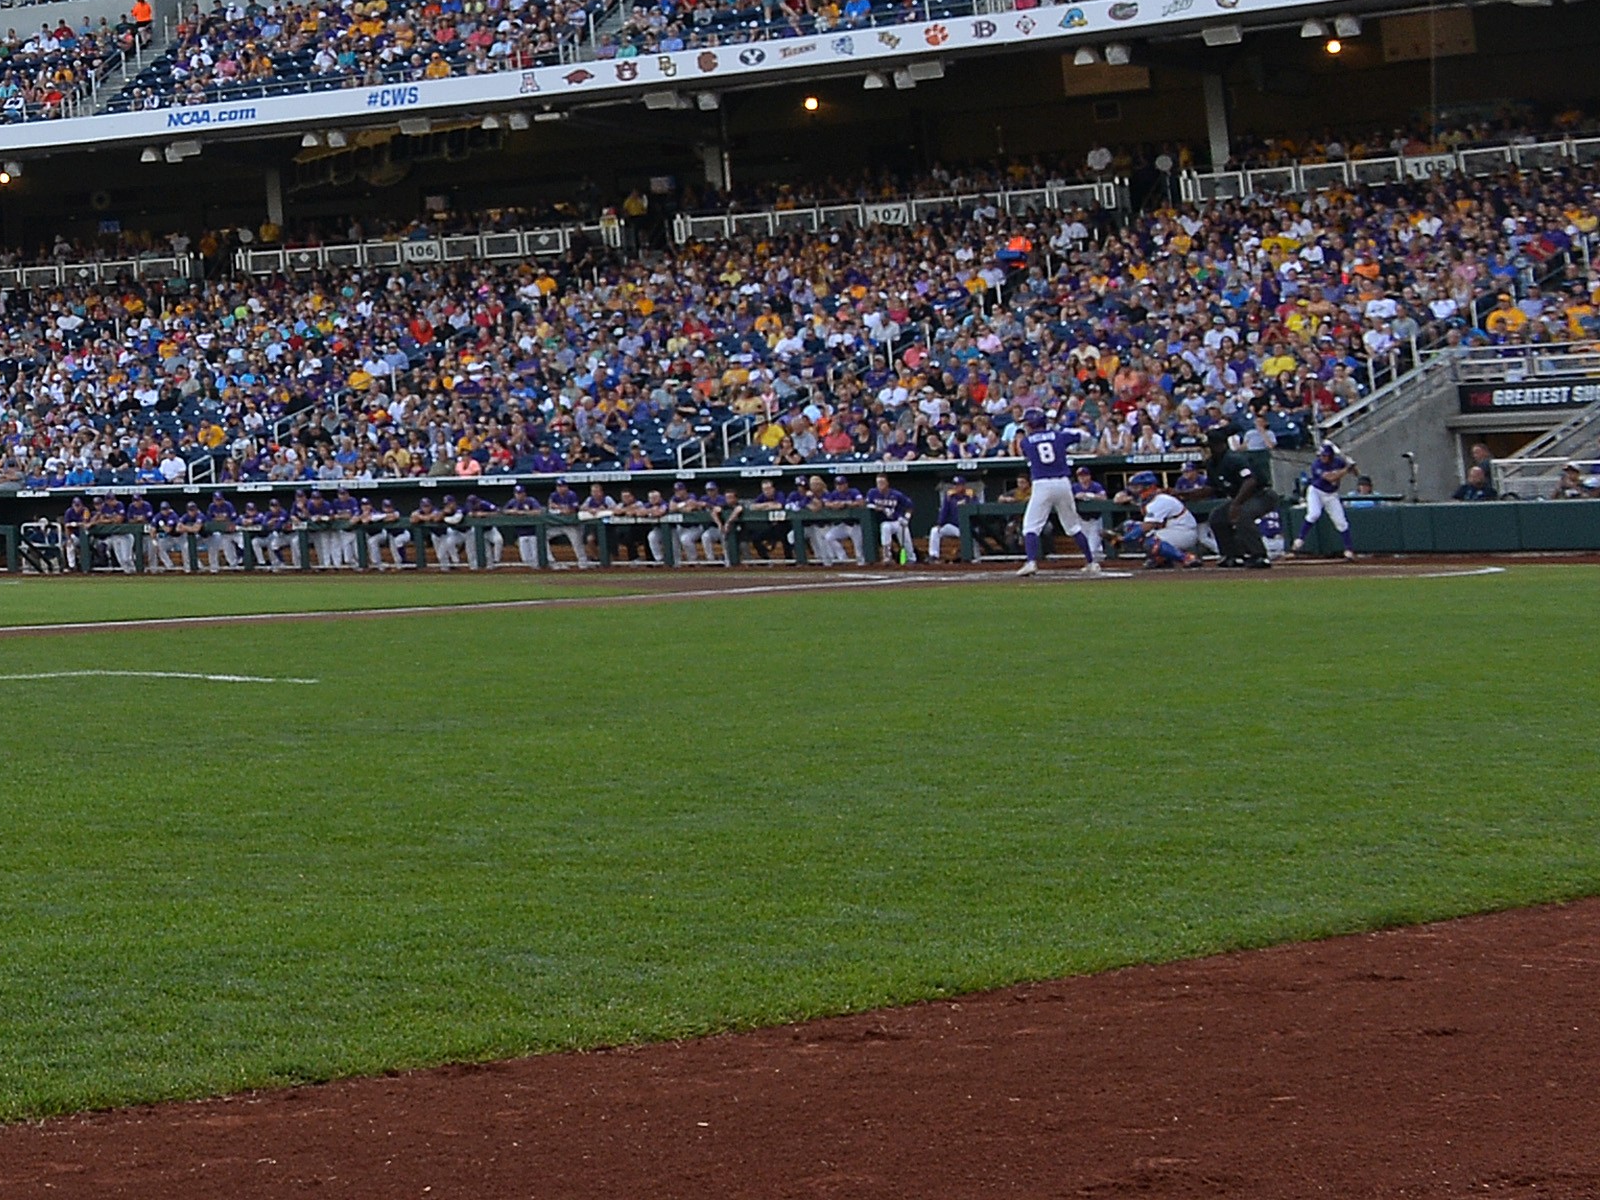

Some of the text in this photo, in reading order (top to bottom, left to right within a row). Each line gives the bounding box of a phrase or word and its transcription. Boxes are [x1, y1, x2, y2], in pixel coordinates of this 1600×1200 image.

[366, 86, 419, 108] #CWS
[167, 107, 256, 128] NCAA.com
[873, 208, 900, 221] 107
[409, 245, 434, 257] 106
[1492, 386, 1571, 406] GREATEST
[1037, 442, 1056, 464] 8
